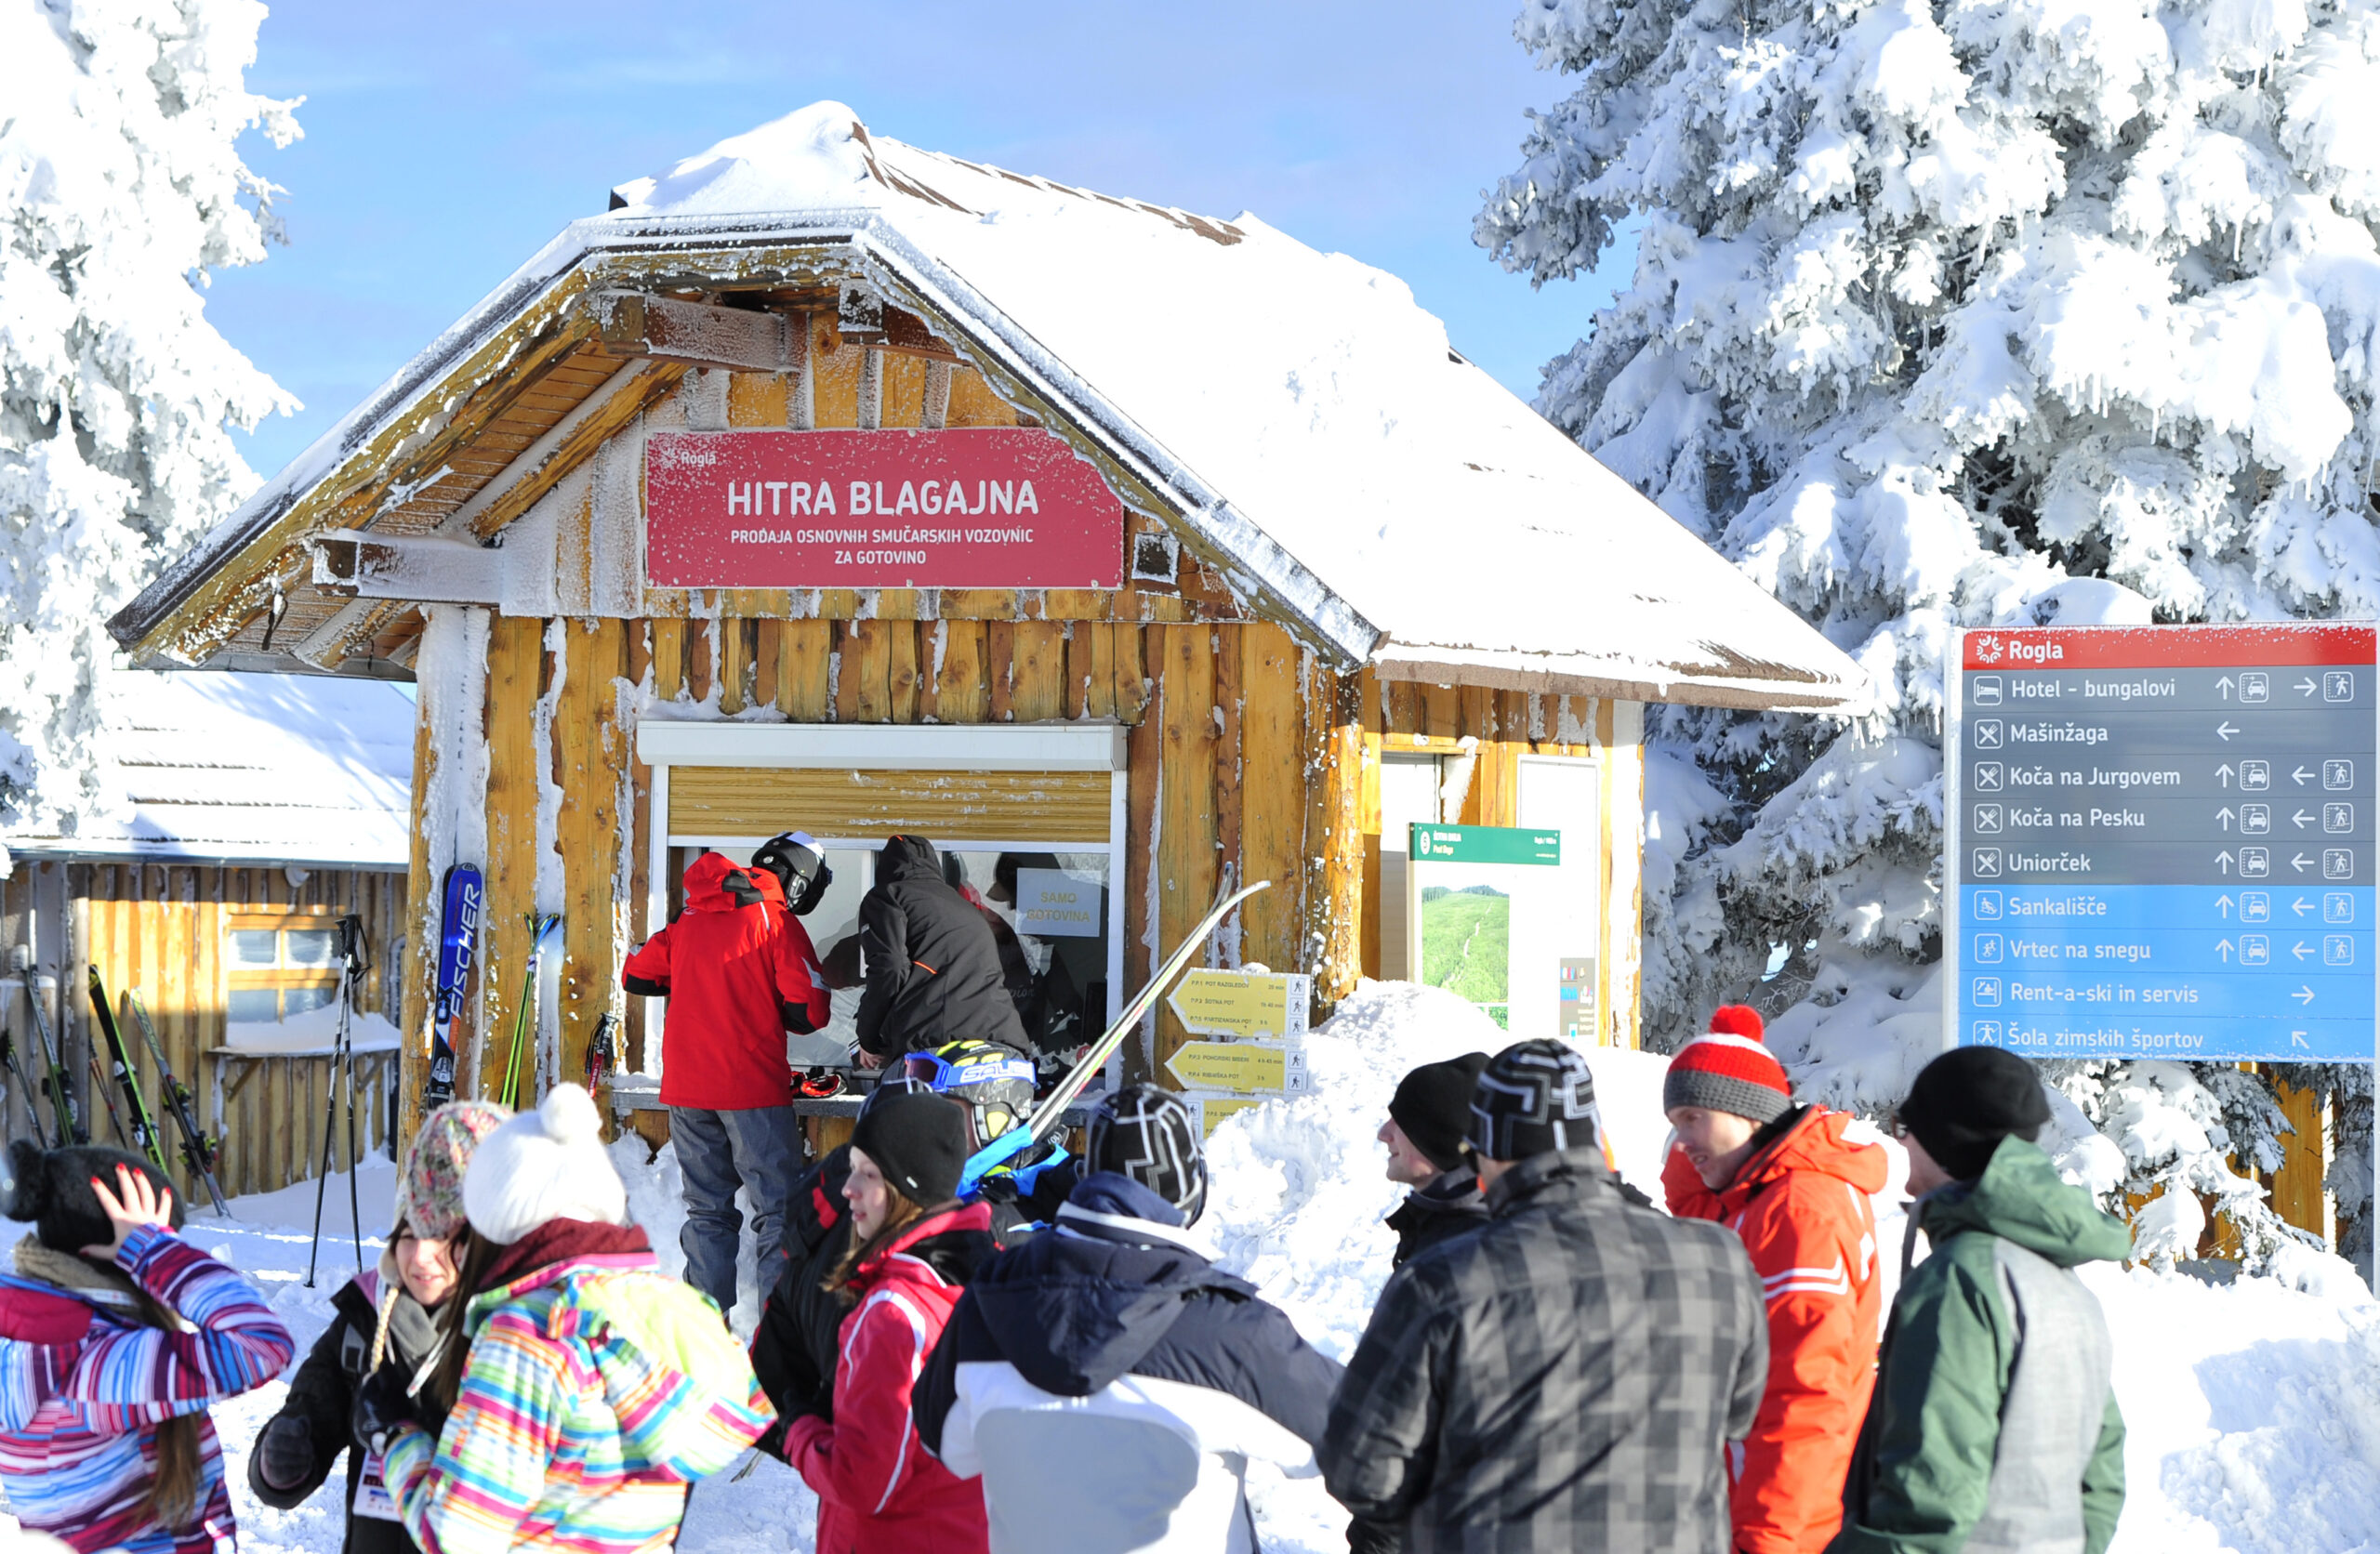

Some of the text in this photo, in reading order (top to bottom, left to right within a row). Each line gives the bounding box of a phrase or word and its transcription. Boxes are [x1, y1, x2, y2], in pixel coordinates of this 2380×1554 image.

[681, 451, 717, 467] Rogla
[727, 480, 1039, 516] HITRA BLAGAJNA
[731, 525, 1034, 544] PRODAJA OSNOVNIH SMUČARSKIH VOZOVNIC
[835, 550, 927, 564] ZA GOTOVINO
[2009, 640, 2064, 663] Rogla
[2012, 679, 2061, 698] Hotel
[2084, 678, 2175, 700] bungalovi
[2010, 722, 2109, 746] Mašinžaga
[2010, 765, 2181, 789] Koča na Jurgovem
[2010, 807, 2146, 827] Koča na Pesku
[2009, 851, 2091, 872] Uniorček
[1040, 891, 1078, 903] SAMO
[2009, 895, 2107, 916] Sankališče
[1026, 908, 1091, 922] GOTOVINA
[450, 883, 481, 1021] FISCHER
[2010, 941, 2151, 964] Vrtec na snegu
[2010, 983, 2199, 1003] Rent-a-ski in servis
[2008, 1021, 2203, 1050] Šola zimskih športov
